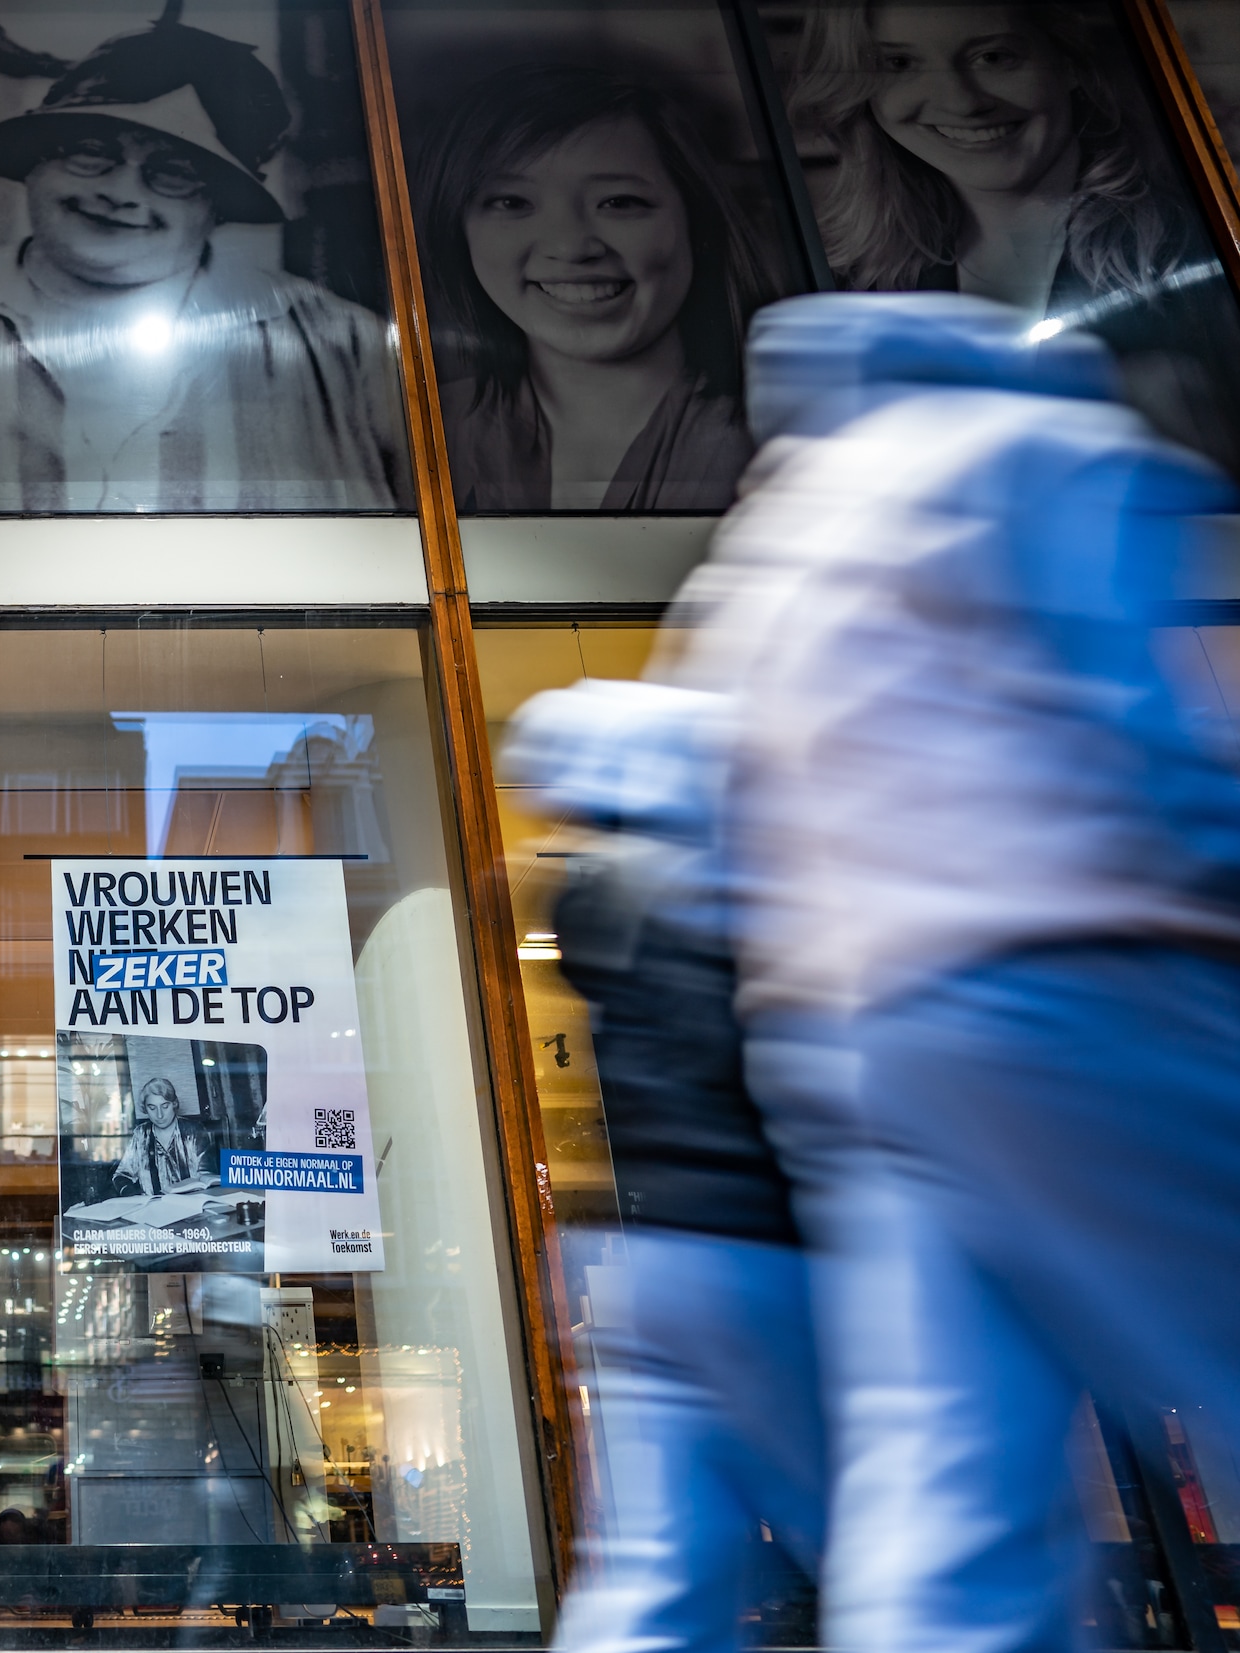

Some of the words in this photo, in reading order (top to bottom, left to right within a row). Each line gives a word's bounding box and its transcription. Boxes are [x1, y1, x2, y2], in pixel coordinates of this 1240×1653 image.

[63, 870, 272, 907] VROUWEN
[65, 908, 238, 946] WERKEN
[95, 952, 226, 990] ZEKER
[68, 988, 159, 1026] AAN
[171, 987, 225, 1025] DE
[230, 985, 315, 1025] TOP
[230, 1154, 263, 1167] ONTDEK
[263, 1156, 274, 1168] JE
[275, 1157, 299, 1169] EIGEN
[300, 1158, 341, 1171] NORMAAL
[341, 1160, 354, 1171] OP
[228, 1166, 357, 1190] MIJNNORMAAL.NL
[73, 1229, 105, 1241] CLARA
[106, 1228, 146, 1241] MEIJERS
[148, 1227, 175, 1242] (1885
[182, 1226, 213, 1242] 1964),
[73, 1242, 108, 1255] EERSTE
[109, 1242, 174, 1254] VROUWELIJKE
[175, 1240, 252, 1254] BANKDIRECTEUR
[330, 1241, 373, 1254] Toekomst
